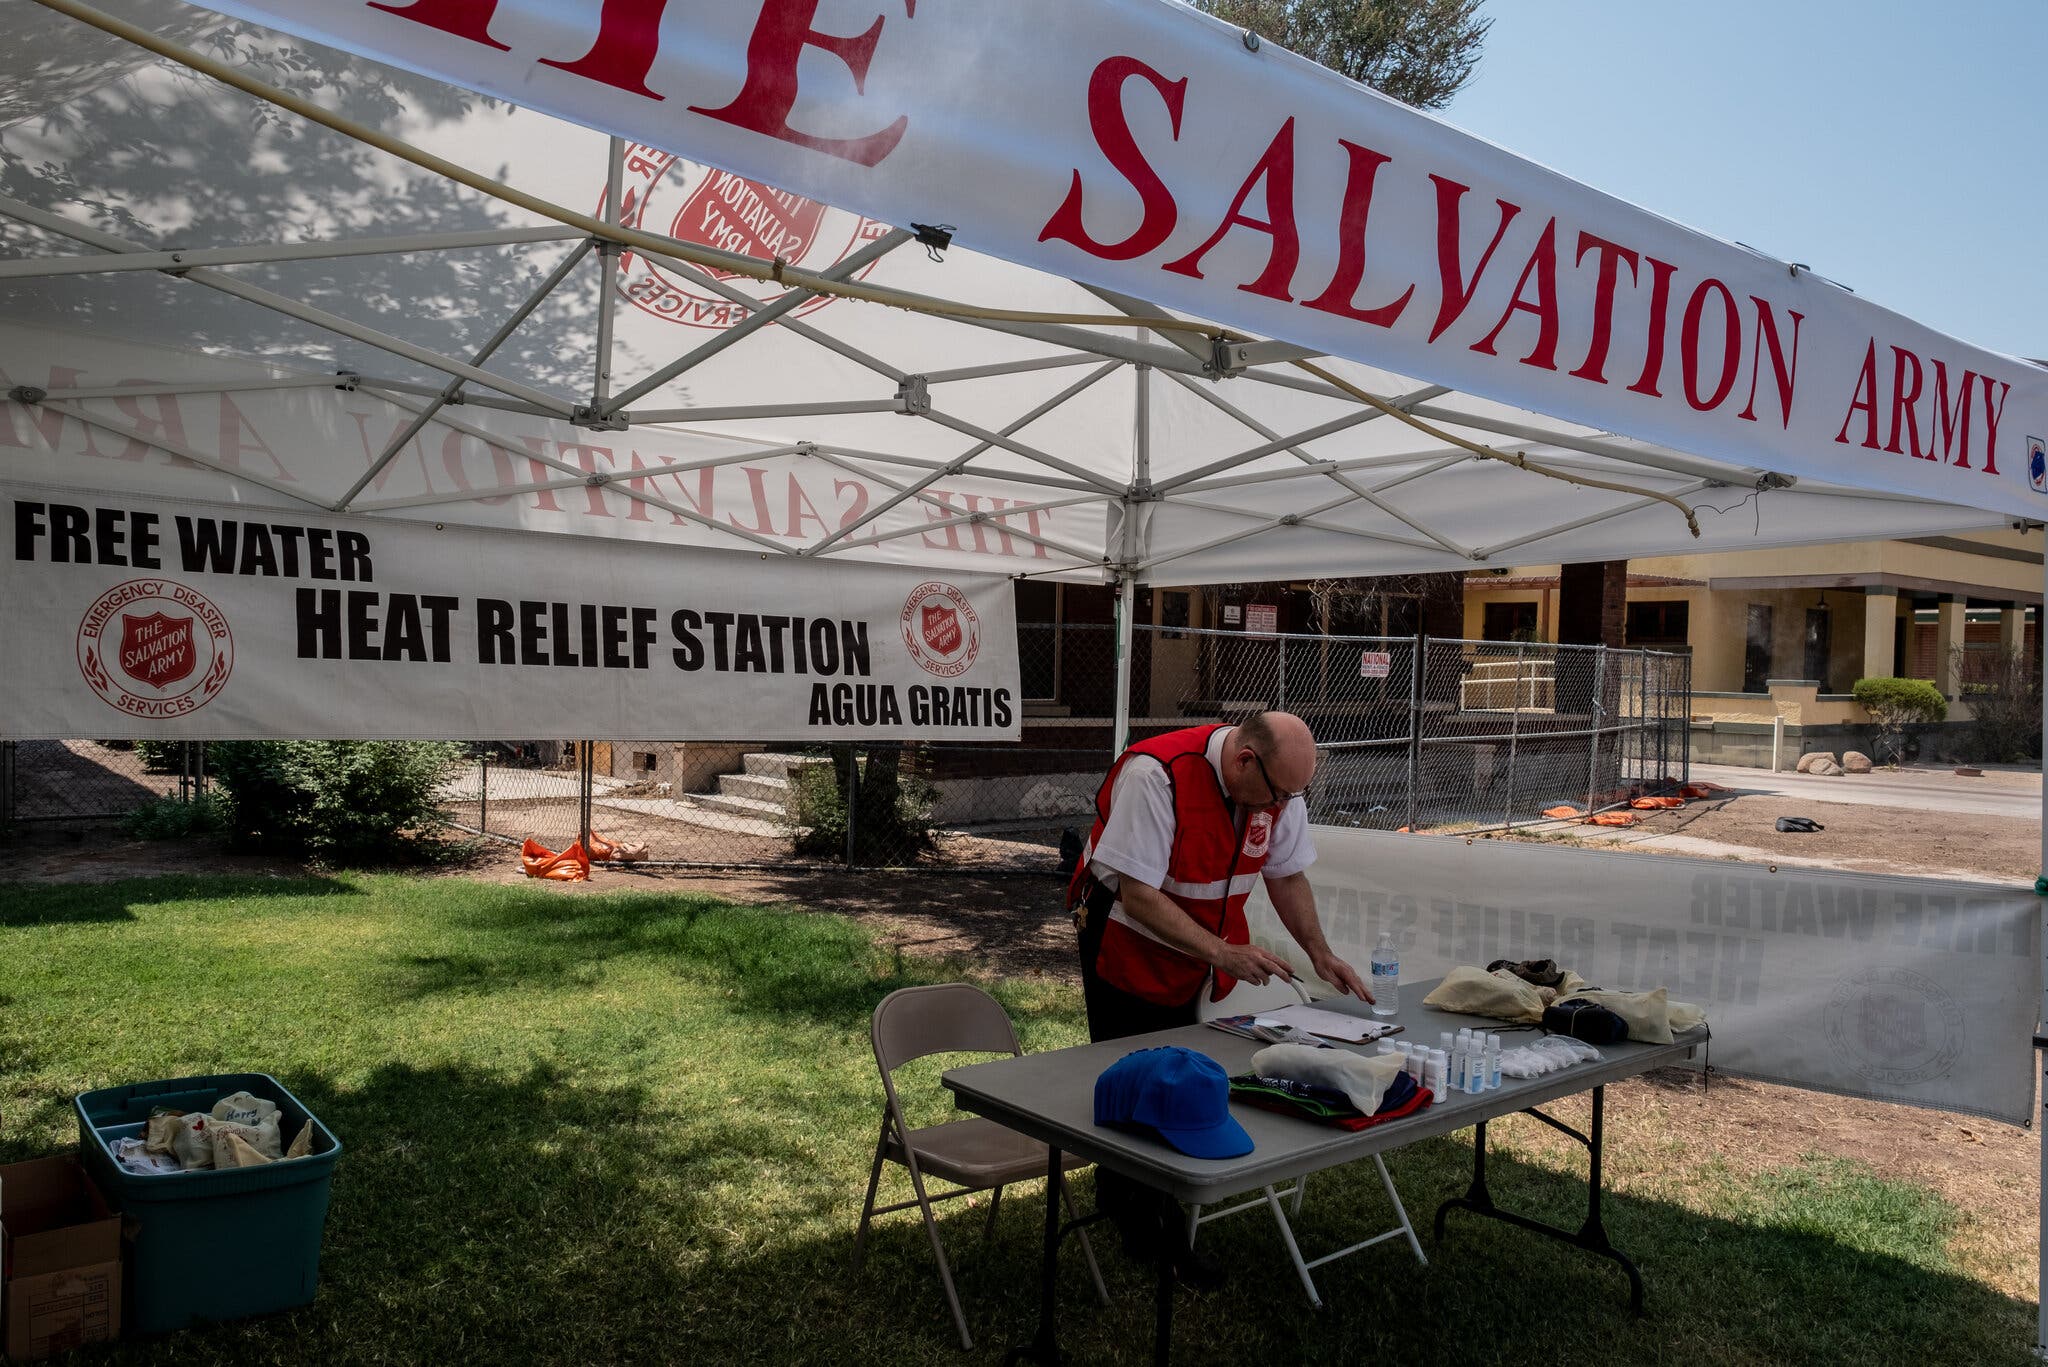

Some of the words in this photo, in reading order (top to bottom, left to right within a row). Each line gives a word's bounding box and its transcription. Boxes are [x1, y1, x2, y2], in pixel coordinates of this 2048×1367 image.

[1038, 56, 1805, 430] SALVATION
[1835, 336, 2010, 475] ARMY
[14, 500, 161, 570] FREE
[175, 515, 373, 582] WATER
[84, 582, 163, 638] EMERGENCY
[174, 586, 226, 639] DISASTER
[903, 584, 941, 622] EMERGENCY
[946, 587, 976, 622] DISASTER
[927, 611, 942, 625] THE
[135, 620, 162, 642] THE
[296, 588, 459, 663] HEAT
[477, 598, 657, 669] RELIEF
[670, 609, 871, 677] STATION
[925, 614, 955, 642] SALVATION
[939, 628, 957, 649] ARMY
[125, 625, 187, 668] SALVATION
[148, 646, 186, 678] ARMY
[1363, 653, 1388, 665] NATIONAL
[925, 660, 964, 675] SERVICES
[117, 694, 194, 715] SERVICES
[808, 683, 902, 726] AGUA
[908, 686, 1012, 728] GRATIS
